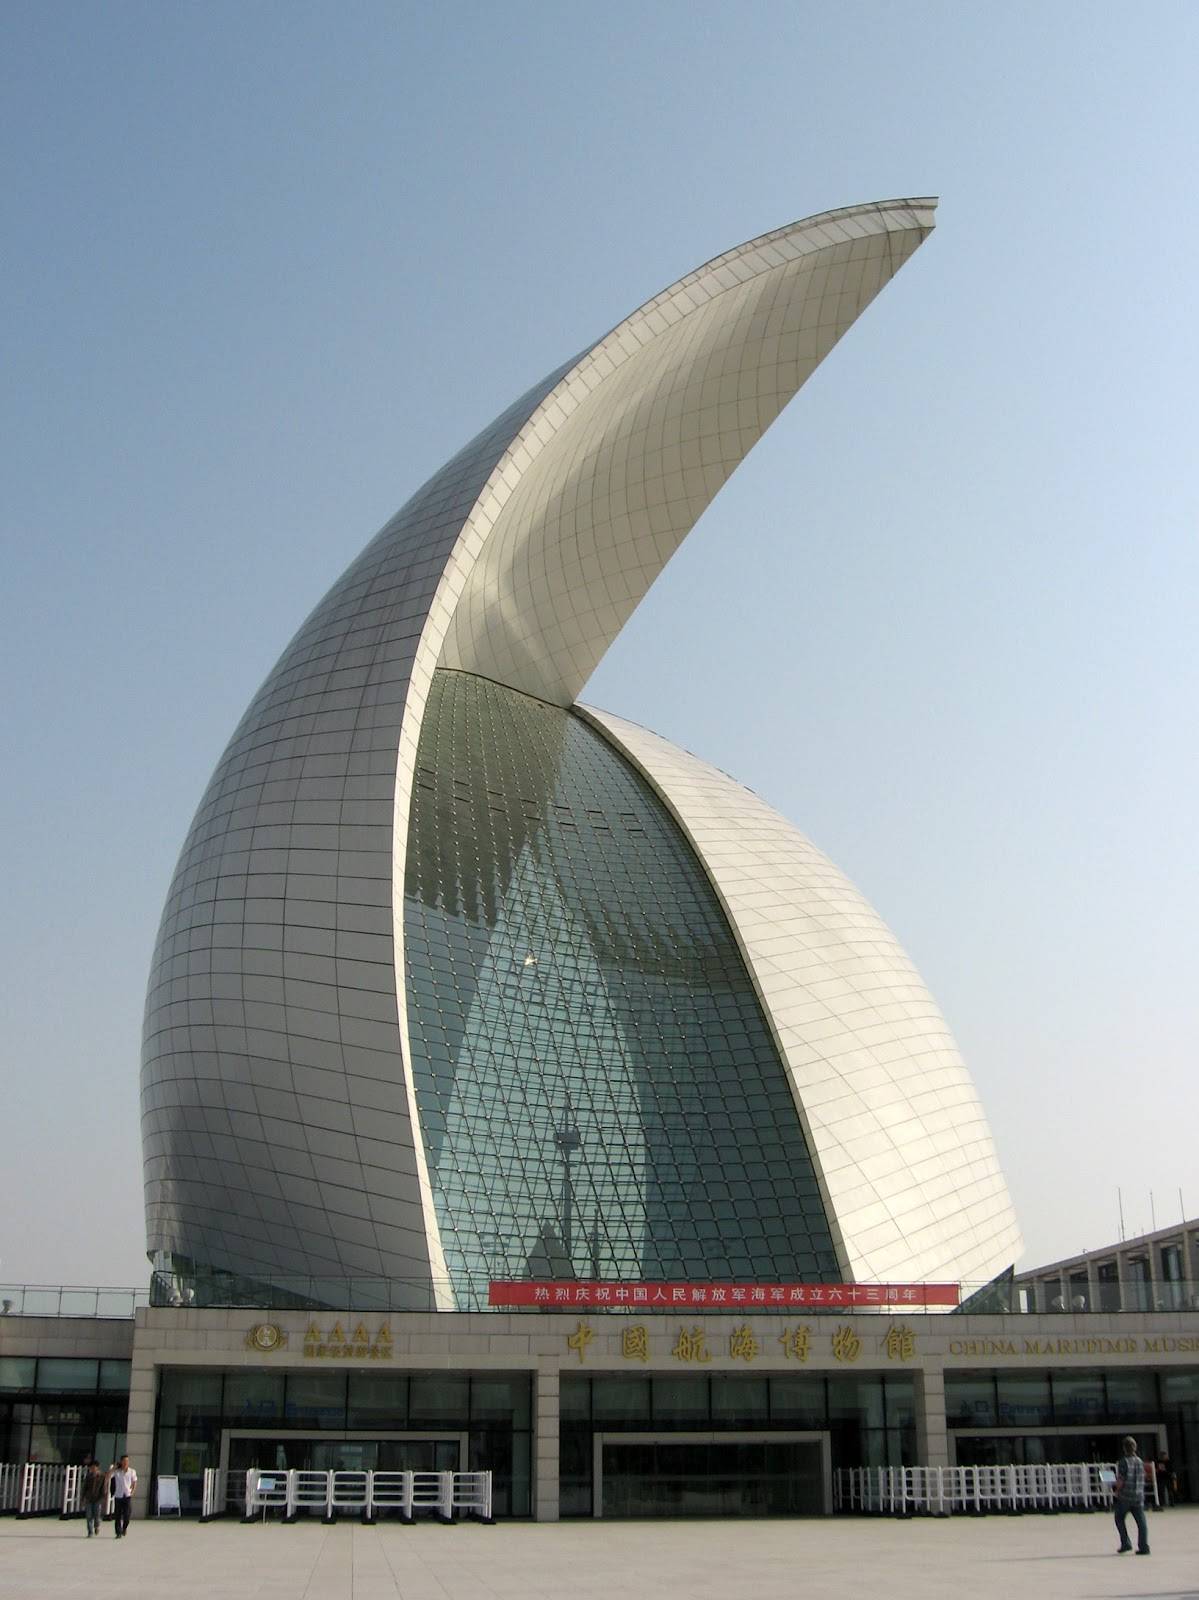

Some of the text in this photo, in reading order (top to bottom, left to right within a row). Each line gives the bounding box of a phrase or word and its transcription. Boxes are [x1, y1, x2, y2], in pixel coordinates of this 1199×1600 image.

[534, 1286, 917, 1302] 热烈庆祝中国人民解放军海军成立六十三周年
[567, 1321, 917, 1364] 中國航海博物館
[949, 1340, 1016, 1355] CHINA
[1023, 1338, 1138, 1354] MARITIME
